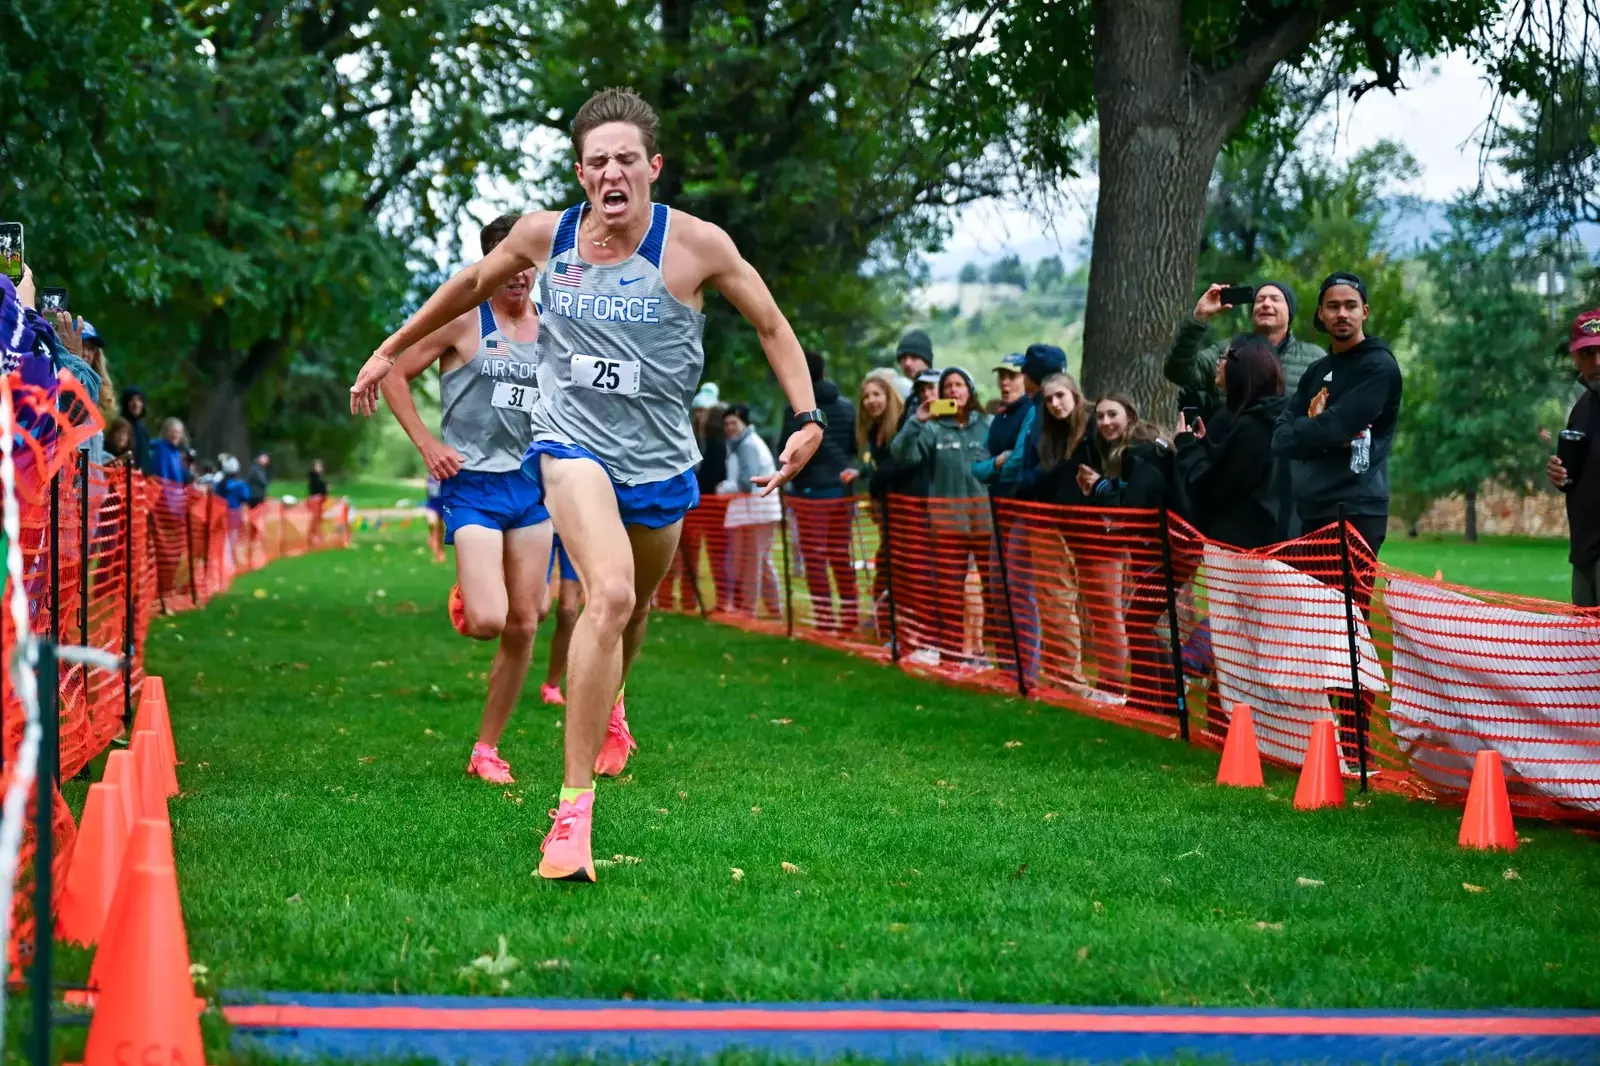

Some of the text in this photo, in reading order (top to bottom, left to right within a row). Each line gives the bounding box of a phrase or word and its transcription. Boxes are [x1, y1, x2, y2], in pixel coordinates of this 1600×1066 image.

[548, 288, 661, 323] AIR FORCE
[480, 359, 506, 377] AIR
[592, 360, 620, 390] 25
[508, 386, 525, 407] 31
